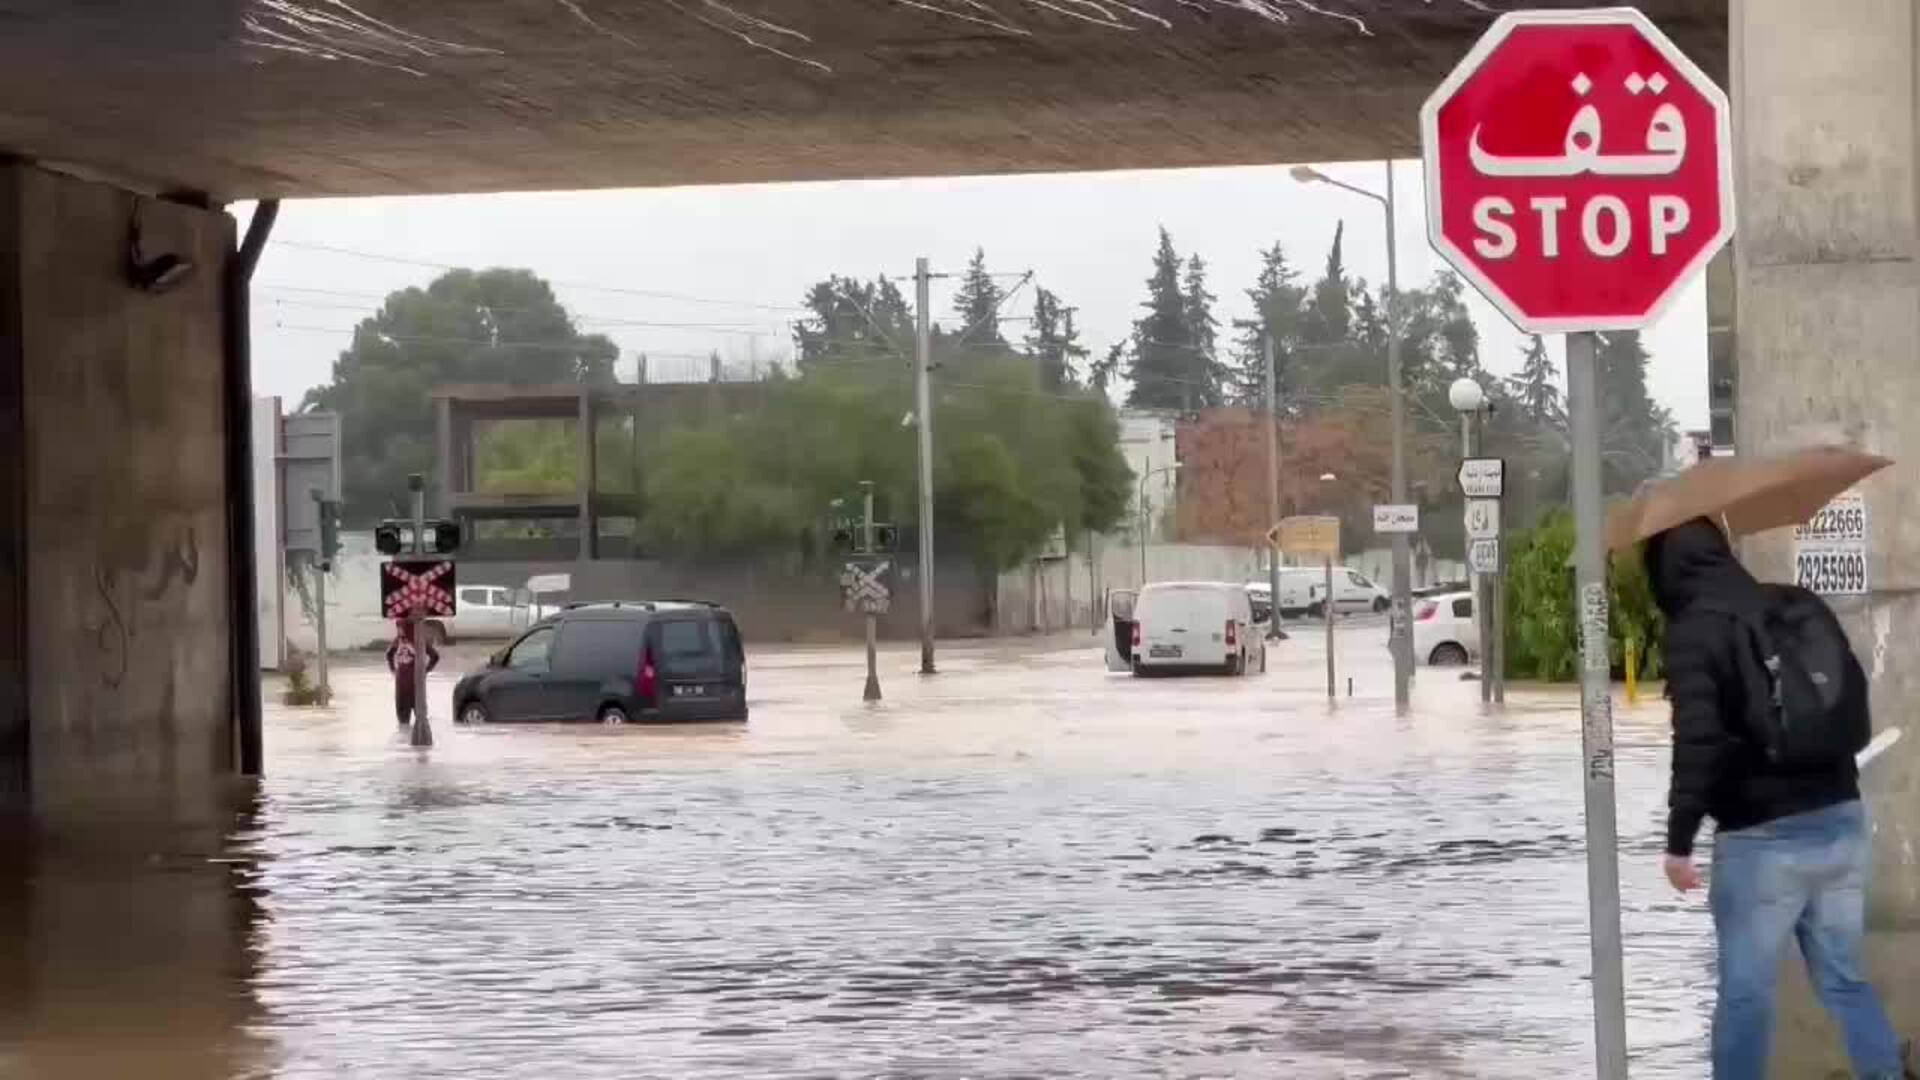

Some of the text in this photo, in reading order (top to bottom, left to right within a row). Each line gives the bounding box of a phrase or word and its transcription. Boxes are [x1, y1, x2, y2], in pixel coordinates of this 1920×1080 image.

[1469, 71, 1686, 176] قف
[1472, 195, 1690, 259] STOP
[1797, 556, 1864, 591] 29255999
